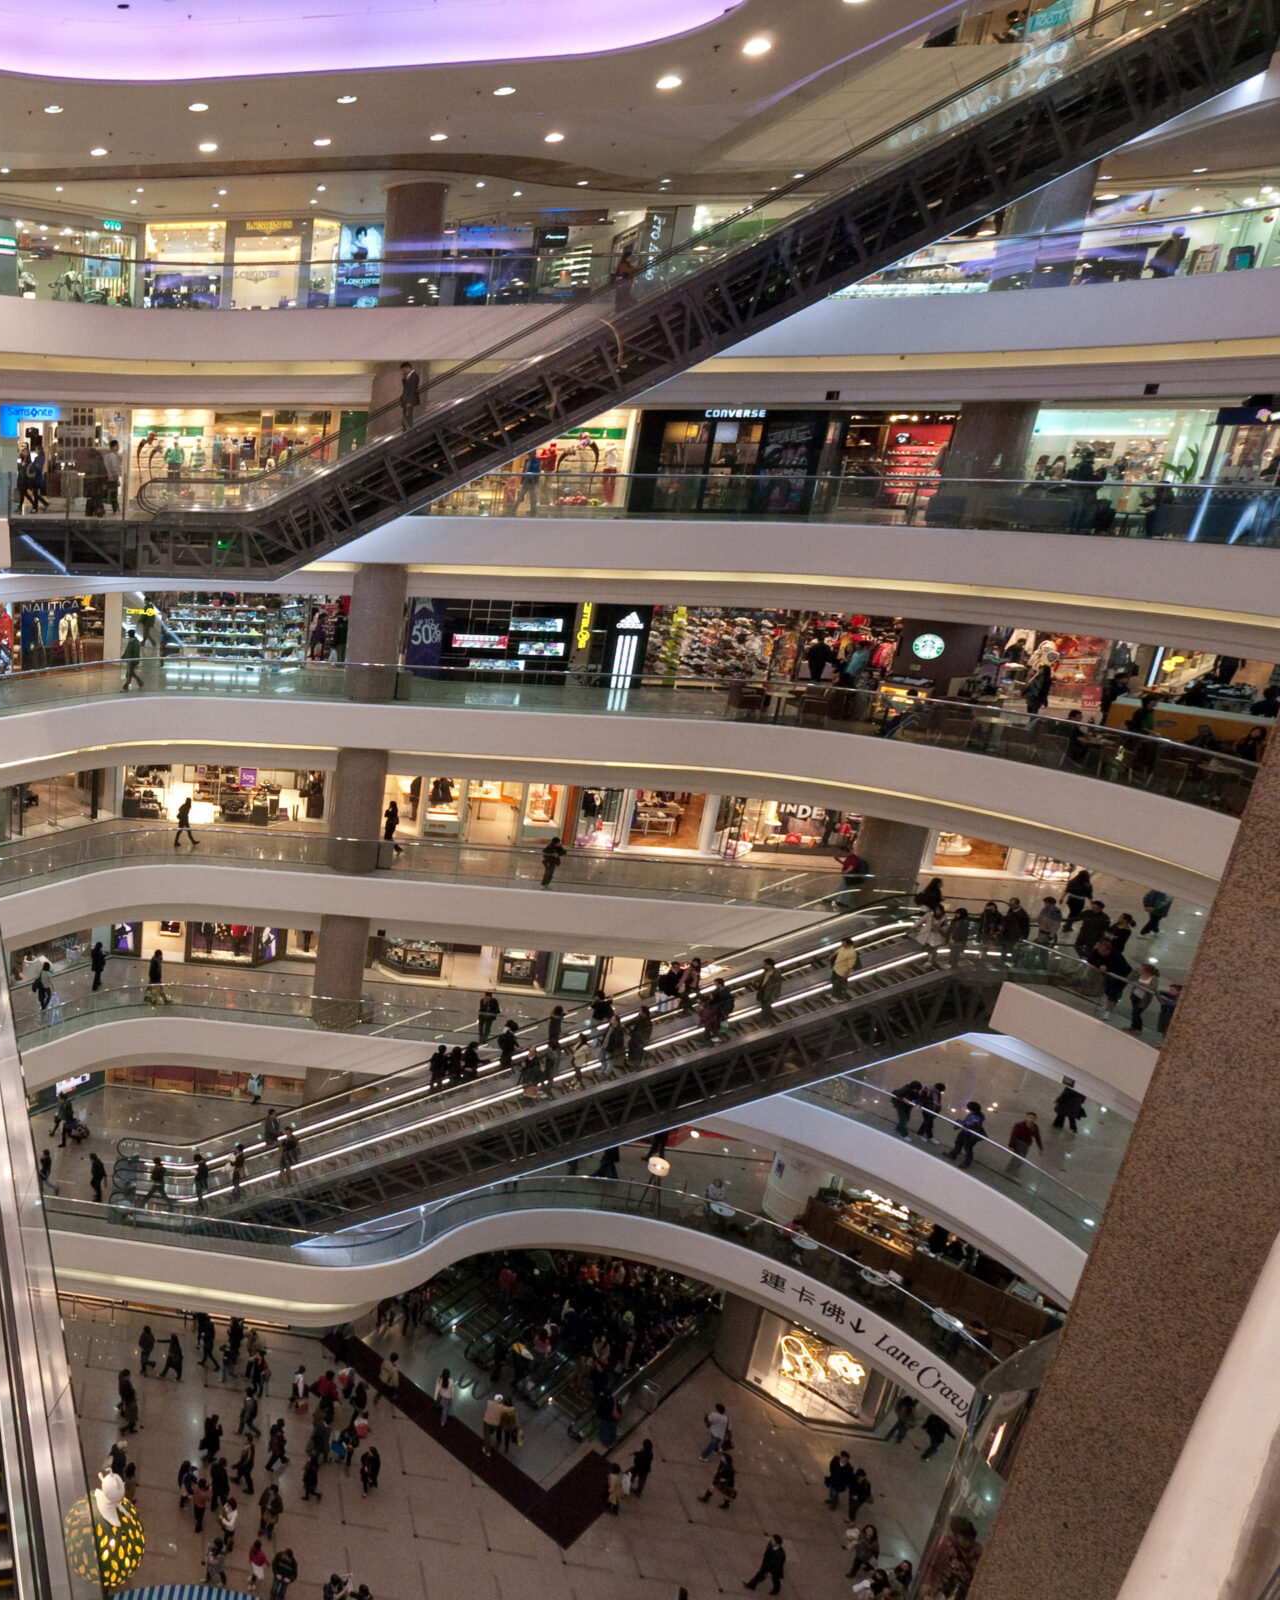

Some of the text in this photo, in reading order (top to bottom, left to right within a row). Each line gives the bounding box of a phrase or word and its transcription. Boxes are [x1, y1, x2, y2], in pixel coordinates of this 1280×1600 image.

[7, 407, 53, 417] Samsonite
[705, 409, 766, 418] CONVERSE
[22, 599, 79, 613] NAUTICA
[760, 1269, 846, 1325] 連卡佛
[874, 1333, 919, 1371] Lane
